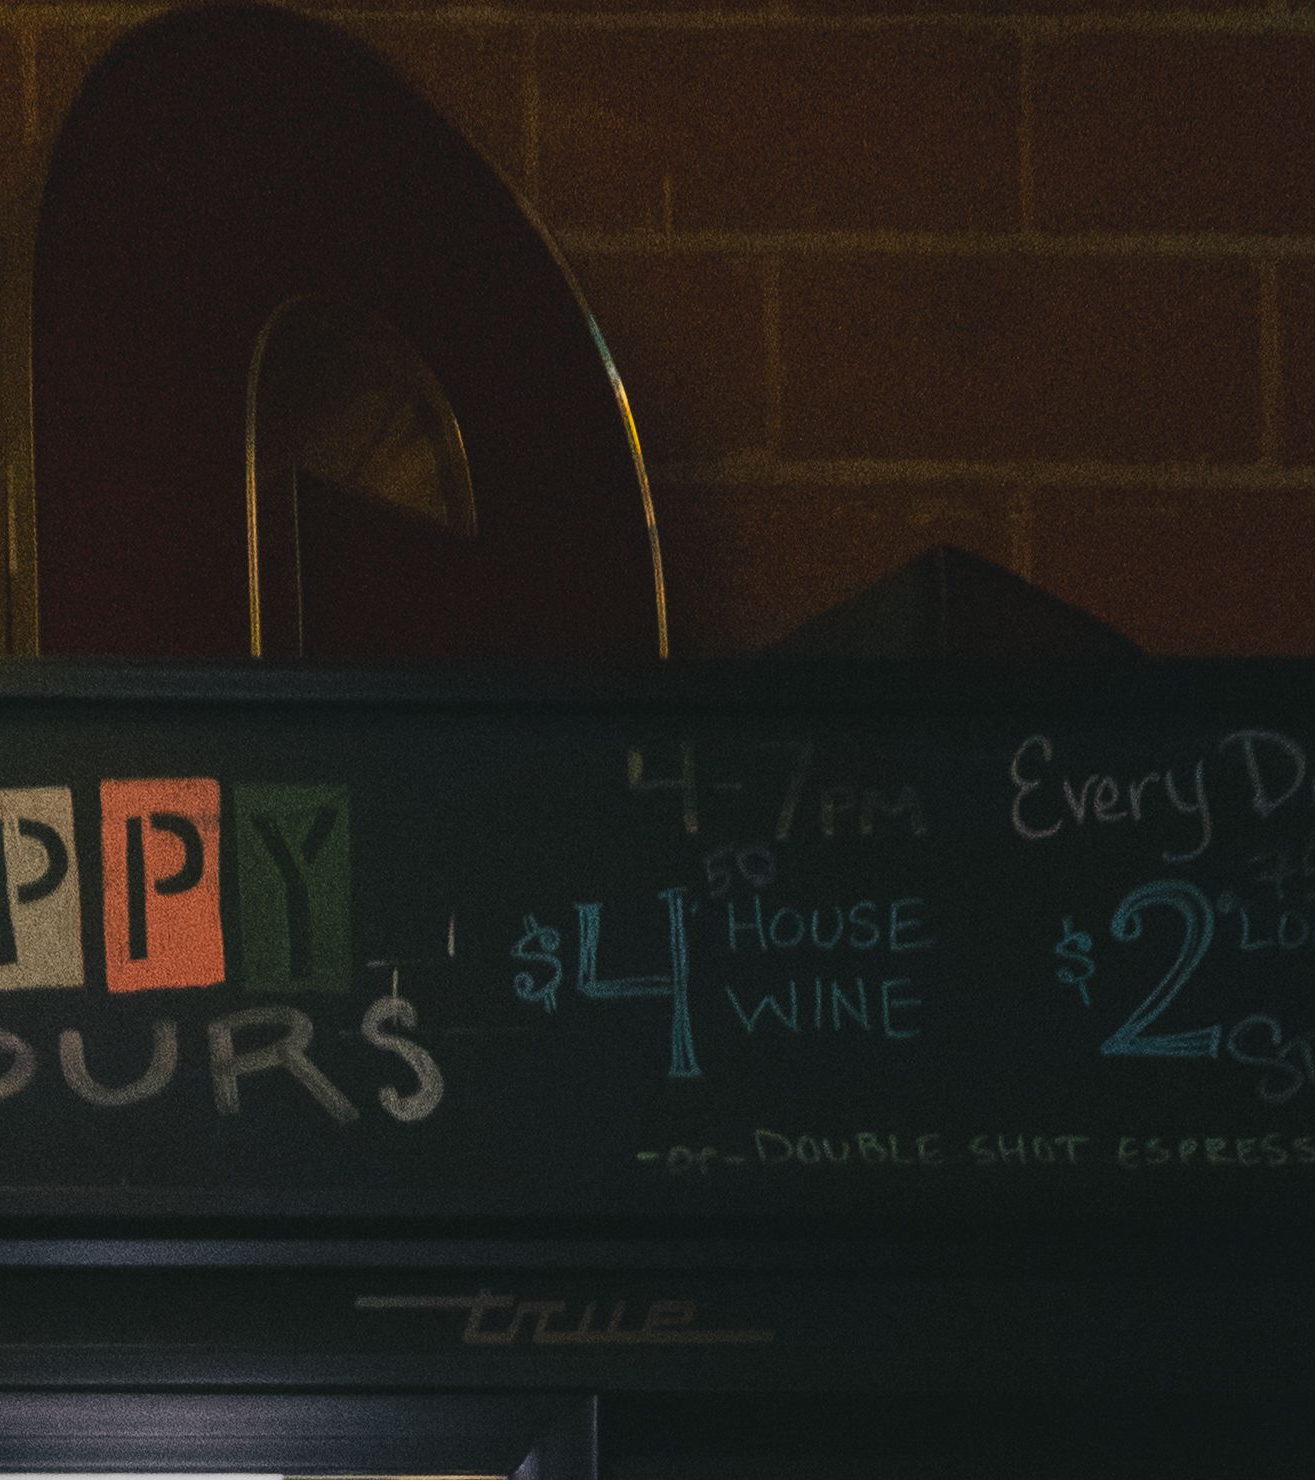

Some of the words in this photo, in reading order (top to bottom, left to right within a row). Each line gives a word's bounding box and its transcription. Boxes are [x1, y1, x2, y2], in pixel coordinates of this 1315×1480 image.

[1007, 733, 1212, 864] Every
[724, 894, 936, 954] HOUSE
[723, 974, 924, 1042] WINE
[967, 1130, 1090, 1167] SHOT
